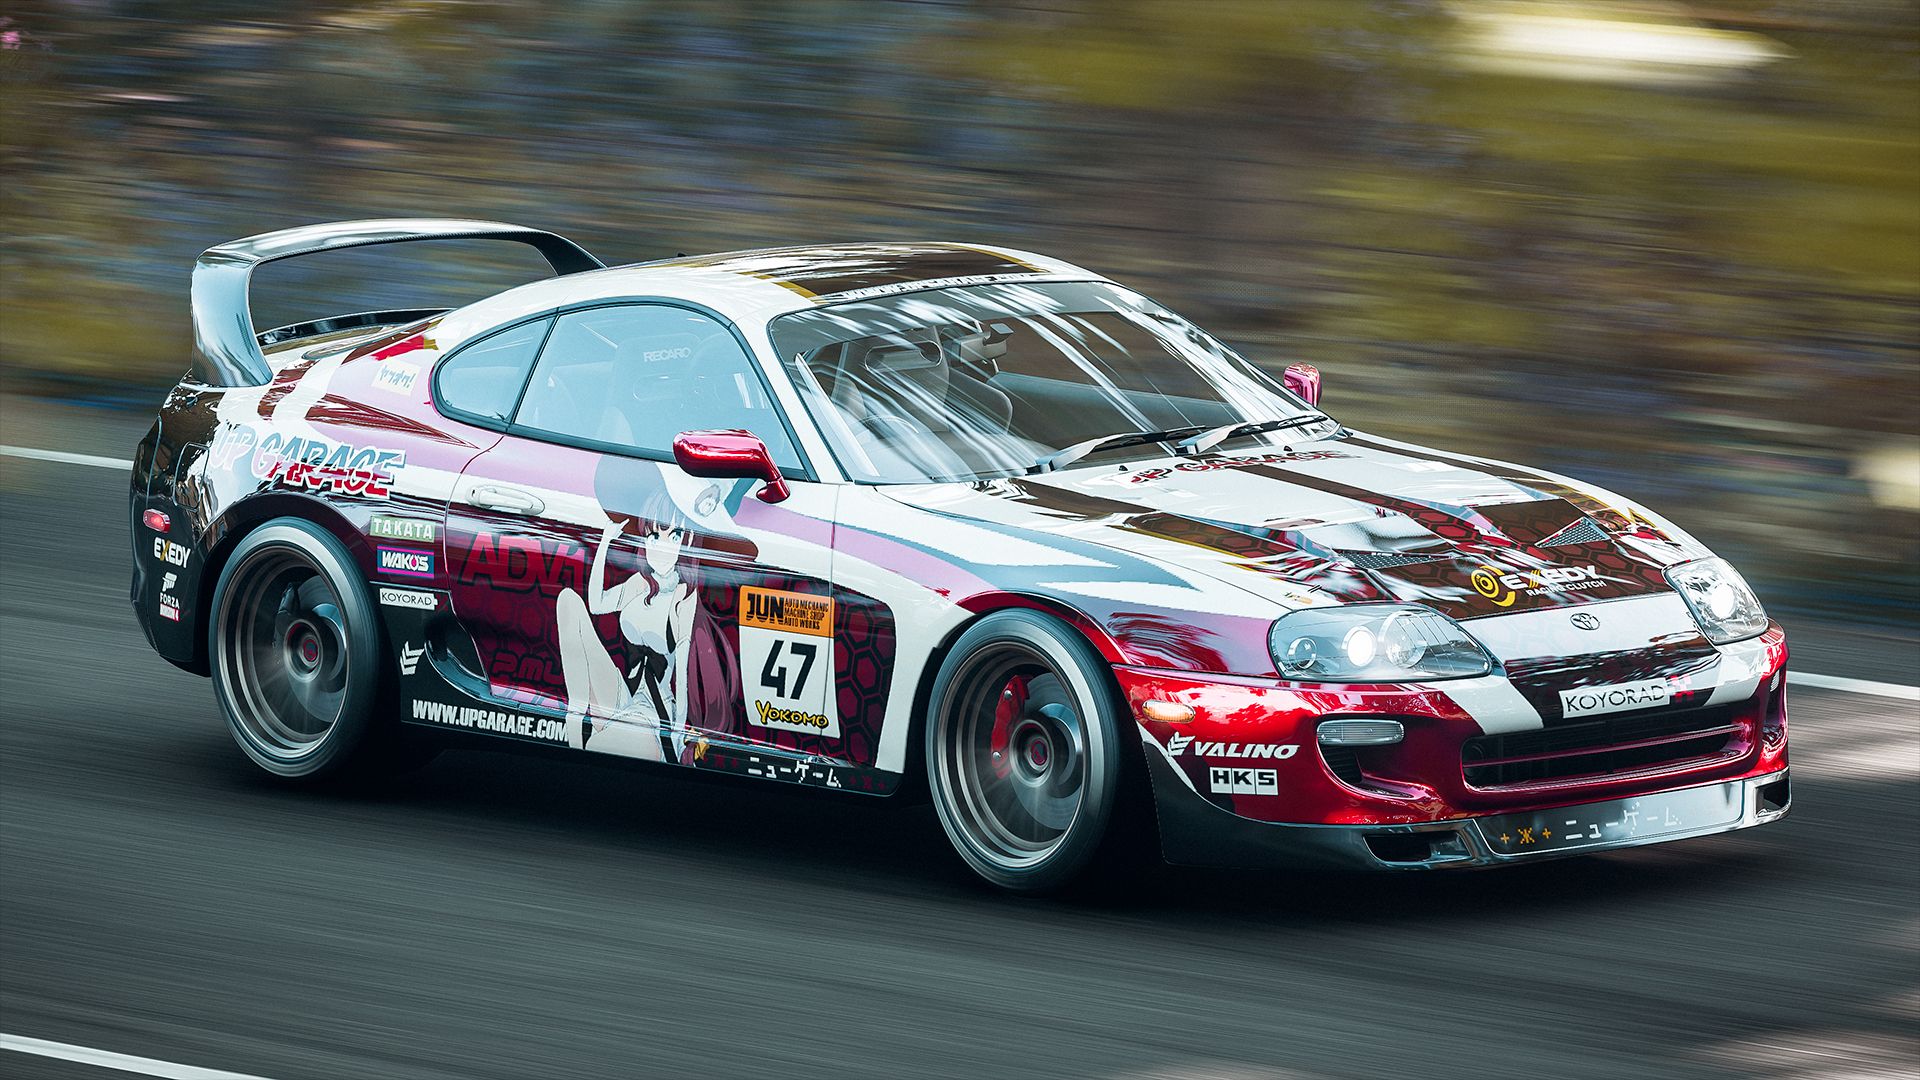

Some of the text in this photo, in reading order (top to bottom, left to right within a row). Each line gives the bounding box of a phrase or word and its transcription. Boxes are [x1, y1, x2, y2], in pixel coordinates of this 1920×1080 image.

[643, 347, 691, 362] RECARO
[210, 424, 405, 500] UP GARAGE
[374, 518, 432, 539] TAKATA
[154, 536, 191, 569] EXEDY
[1500, 565, 1600, 590] EXEDY
[1525, 580, 1607, 597] RACING CLUTCH
[160, 592, 180, 609] FORZA
[381, 592, 432, 606] KOYORAD
[746, 592, 784, 625] JUN
[785, 598, 799, 608] AUTO
[784, 615, 798, 627] AUTO
[760, 639, 817, 700] 47
[1565, 685, 1665, 712] KOYORAD
[412, 699, 569, 742] WWW.UPGARAGE.COM
[755, 699, 830, 729] YOKOMO
[1195, 741, 1300, 759] VALINO
[748, 755, 842, 789] ニューゲーム
[1211, 769, 1277, 788] HKS
[1565, 801, 1682, 840] ニューゲーム
